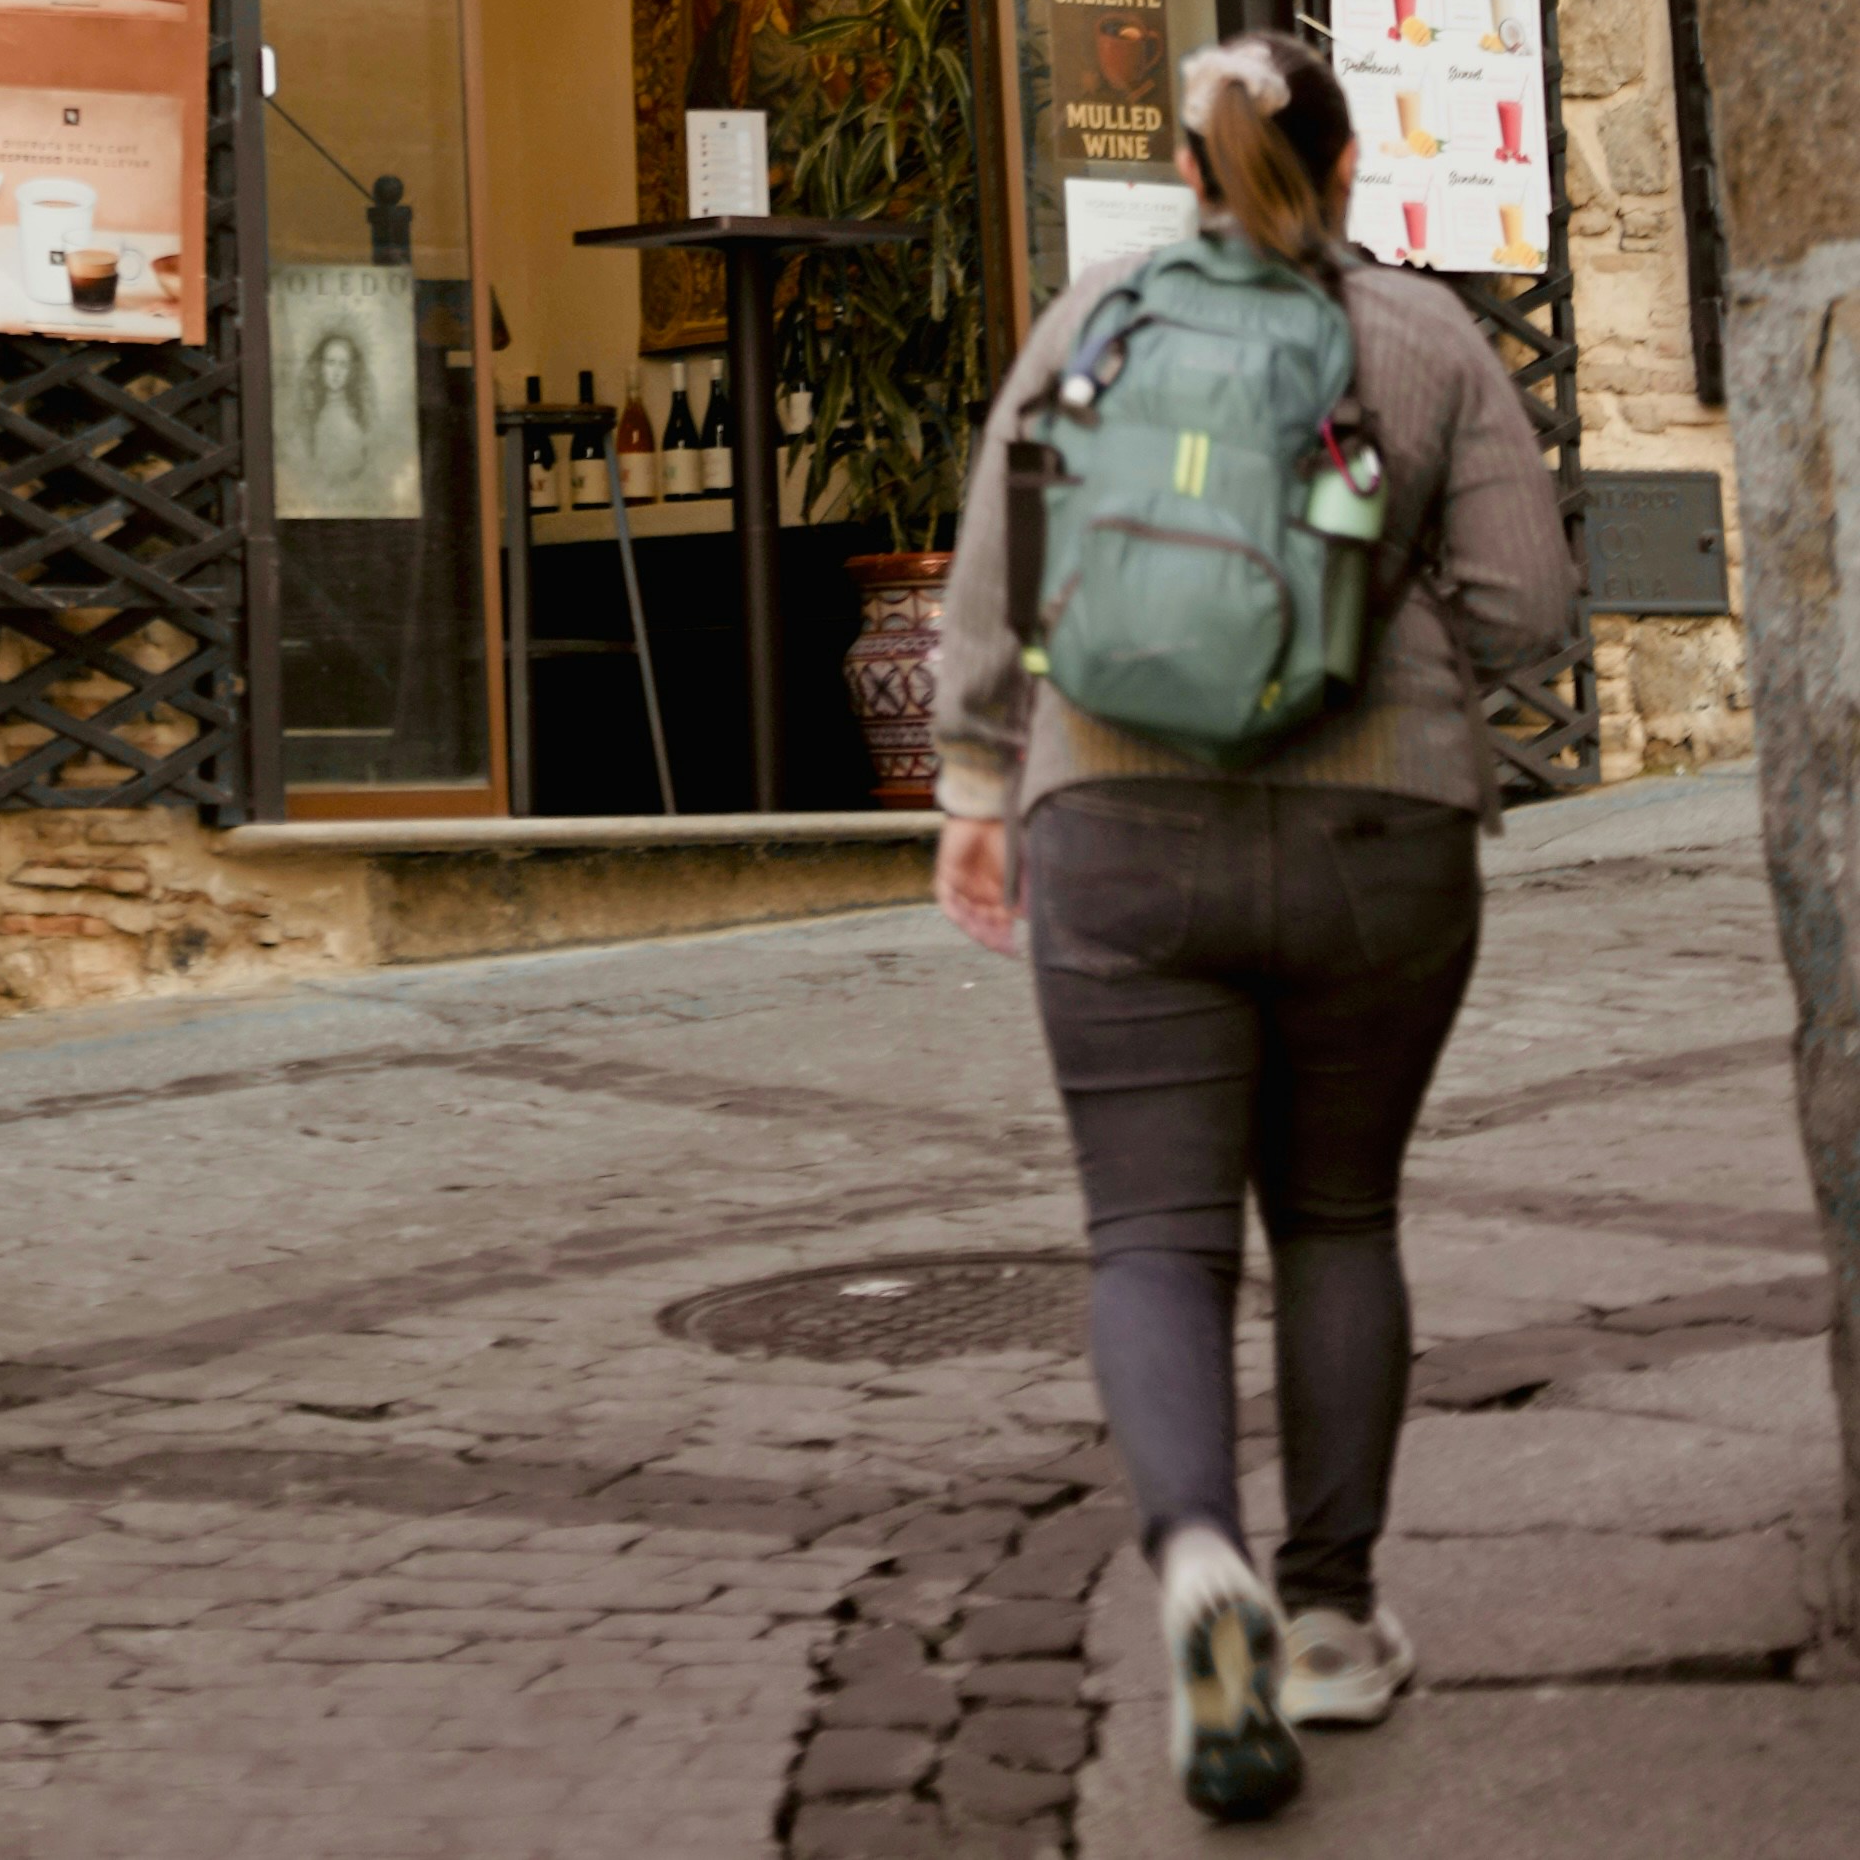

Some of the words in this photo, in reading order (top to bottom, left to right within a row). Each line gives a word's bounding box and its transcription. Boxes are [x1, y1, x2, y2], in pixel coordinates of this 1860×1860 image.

[1066, 101, 1163, 132] MULLED
[1082, 133, 1150, 161] WINE
[285, 272, 409, 298] OLEDO
